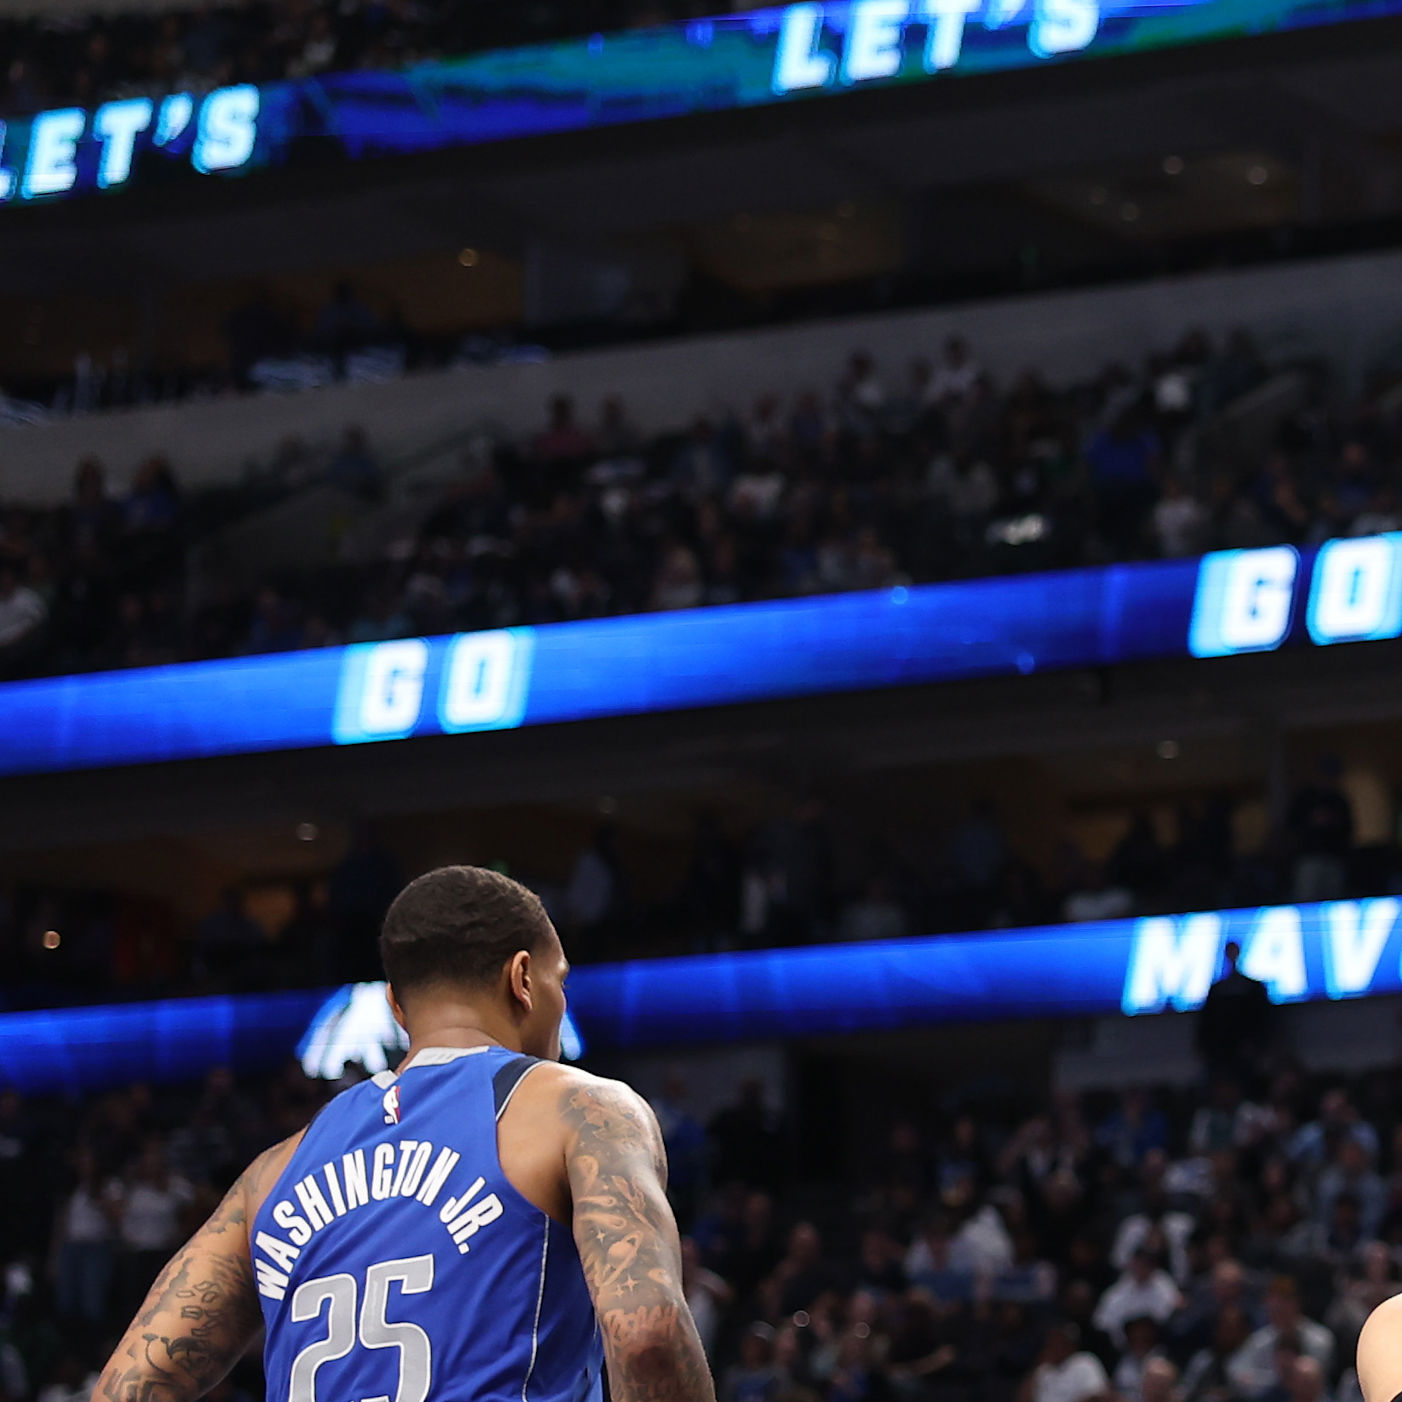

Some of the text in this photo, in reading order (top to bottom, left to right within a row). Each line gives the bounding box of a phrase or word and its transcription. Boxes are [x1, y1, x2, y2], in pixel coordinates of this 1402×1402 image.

[331, 625, 538, 746] GO
[254, 1140, 504, 1301] WASHINGTON JR.
